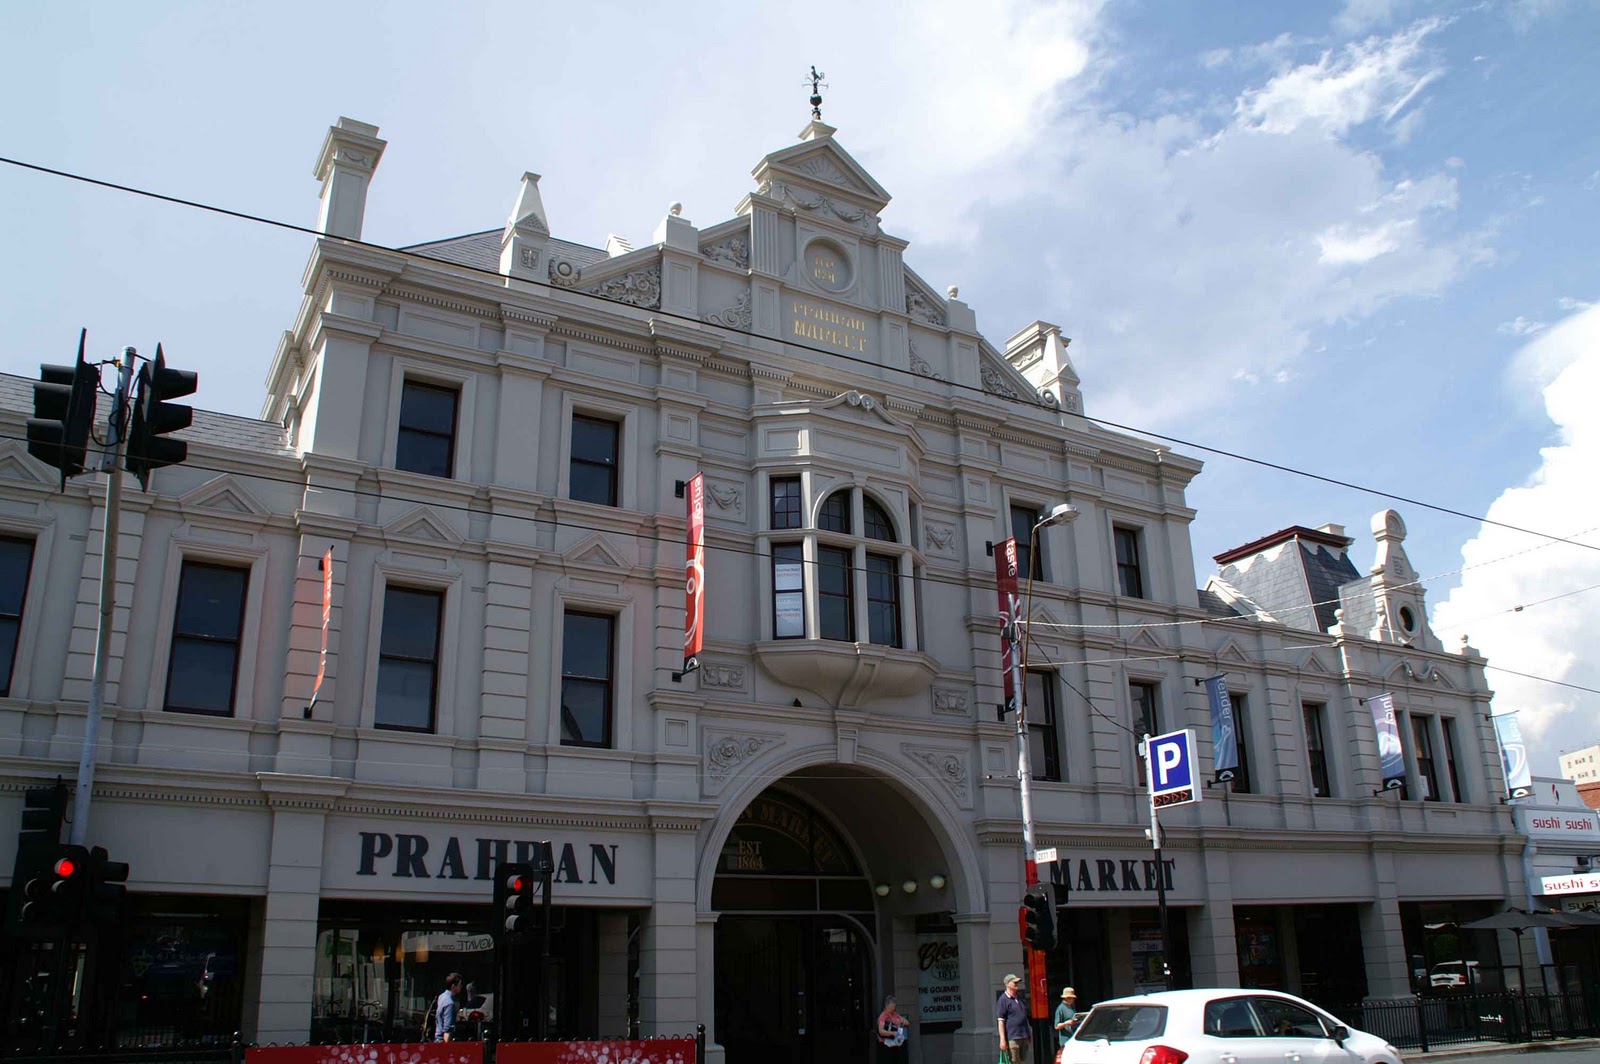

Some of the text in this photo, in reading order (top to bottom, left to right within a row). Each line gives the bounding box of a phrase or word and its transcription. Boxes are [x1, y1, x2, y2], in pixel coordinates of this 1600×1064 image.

[694, 478, 703, 519] enjoy
[1005, 539, 1018, 578] taste
[1380, 695, 1395, 725] juicy
[1158, 743, 1180, 785] P
[1532, 816, 1593, 831] sushi sushi
[355, 831, 619, 886] PRAHRAN
[739, 841, 762, 854] EST
[1037, 852, 1048, 861] ZETT
[1049, 858, 1176, 891] MARKET
[1544, 878, 1600, 891] sushi s
[930, 985, 960, 994] GOURMET
